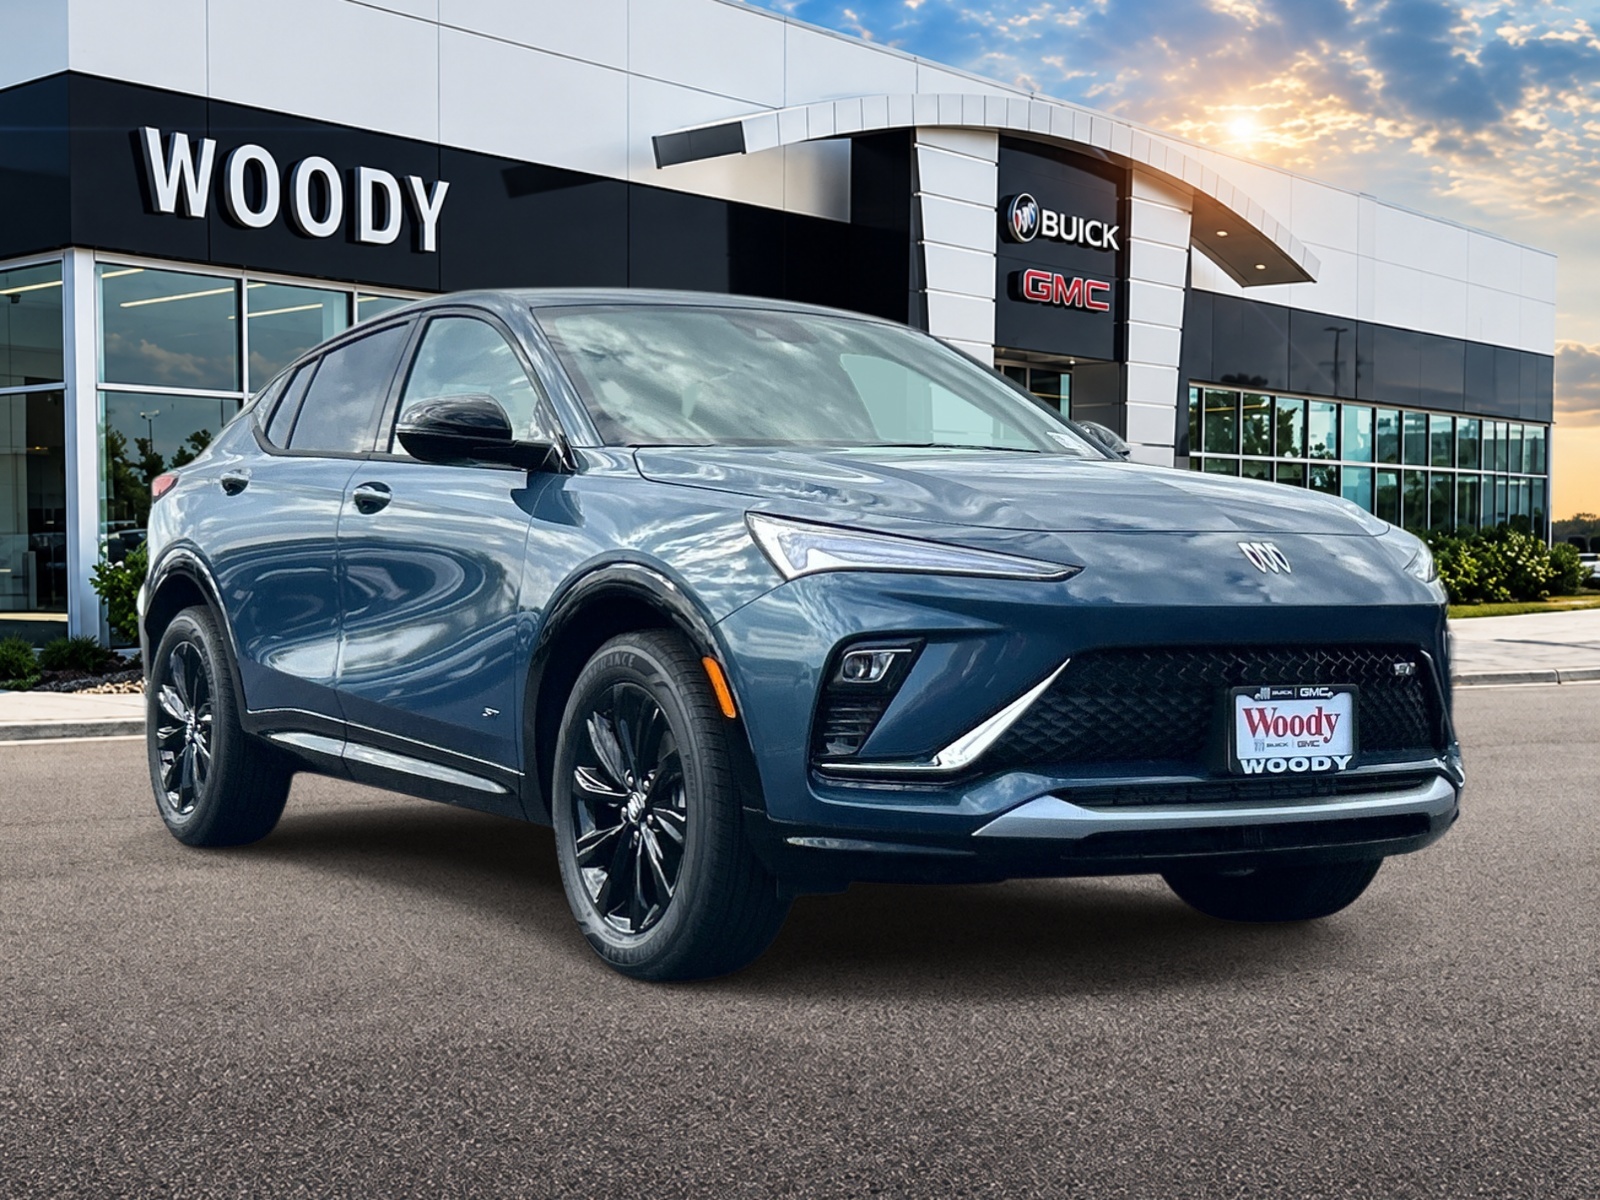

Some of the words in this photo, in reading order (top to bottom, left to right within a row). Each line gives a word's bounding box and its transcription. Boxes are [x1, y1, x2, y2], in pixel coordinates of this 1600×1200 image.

[139, 126, 450, 252] WOODY
[1041, 208, 1120, 250] BUICK
[1023, 268, 1110, 311] GMC
[1300, 687, 1330, 697] GMC
[1242, 706, 1341, 744] Woody
[1297, 740, 1320, 748] GMC
[1240, 755, 1353, 775] WOODY
